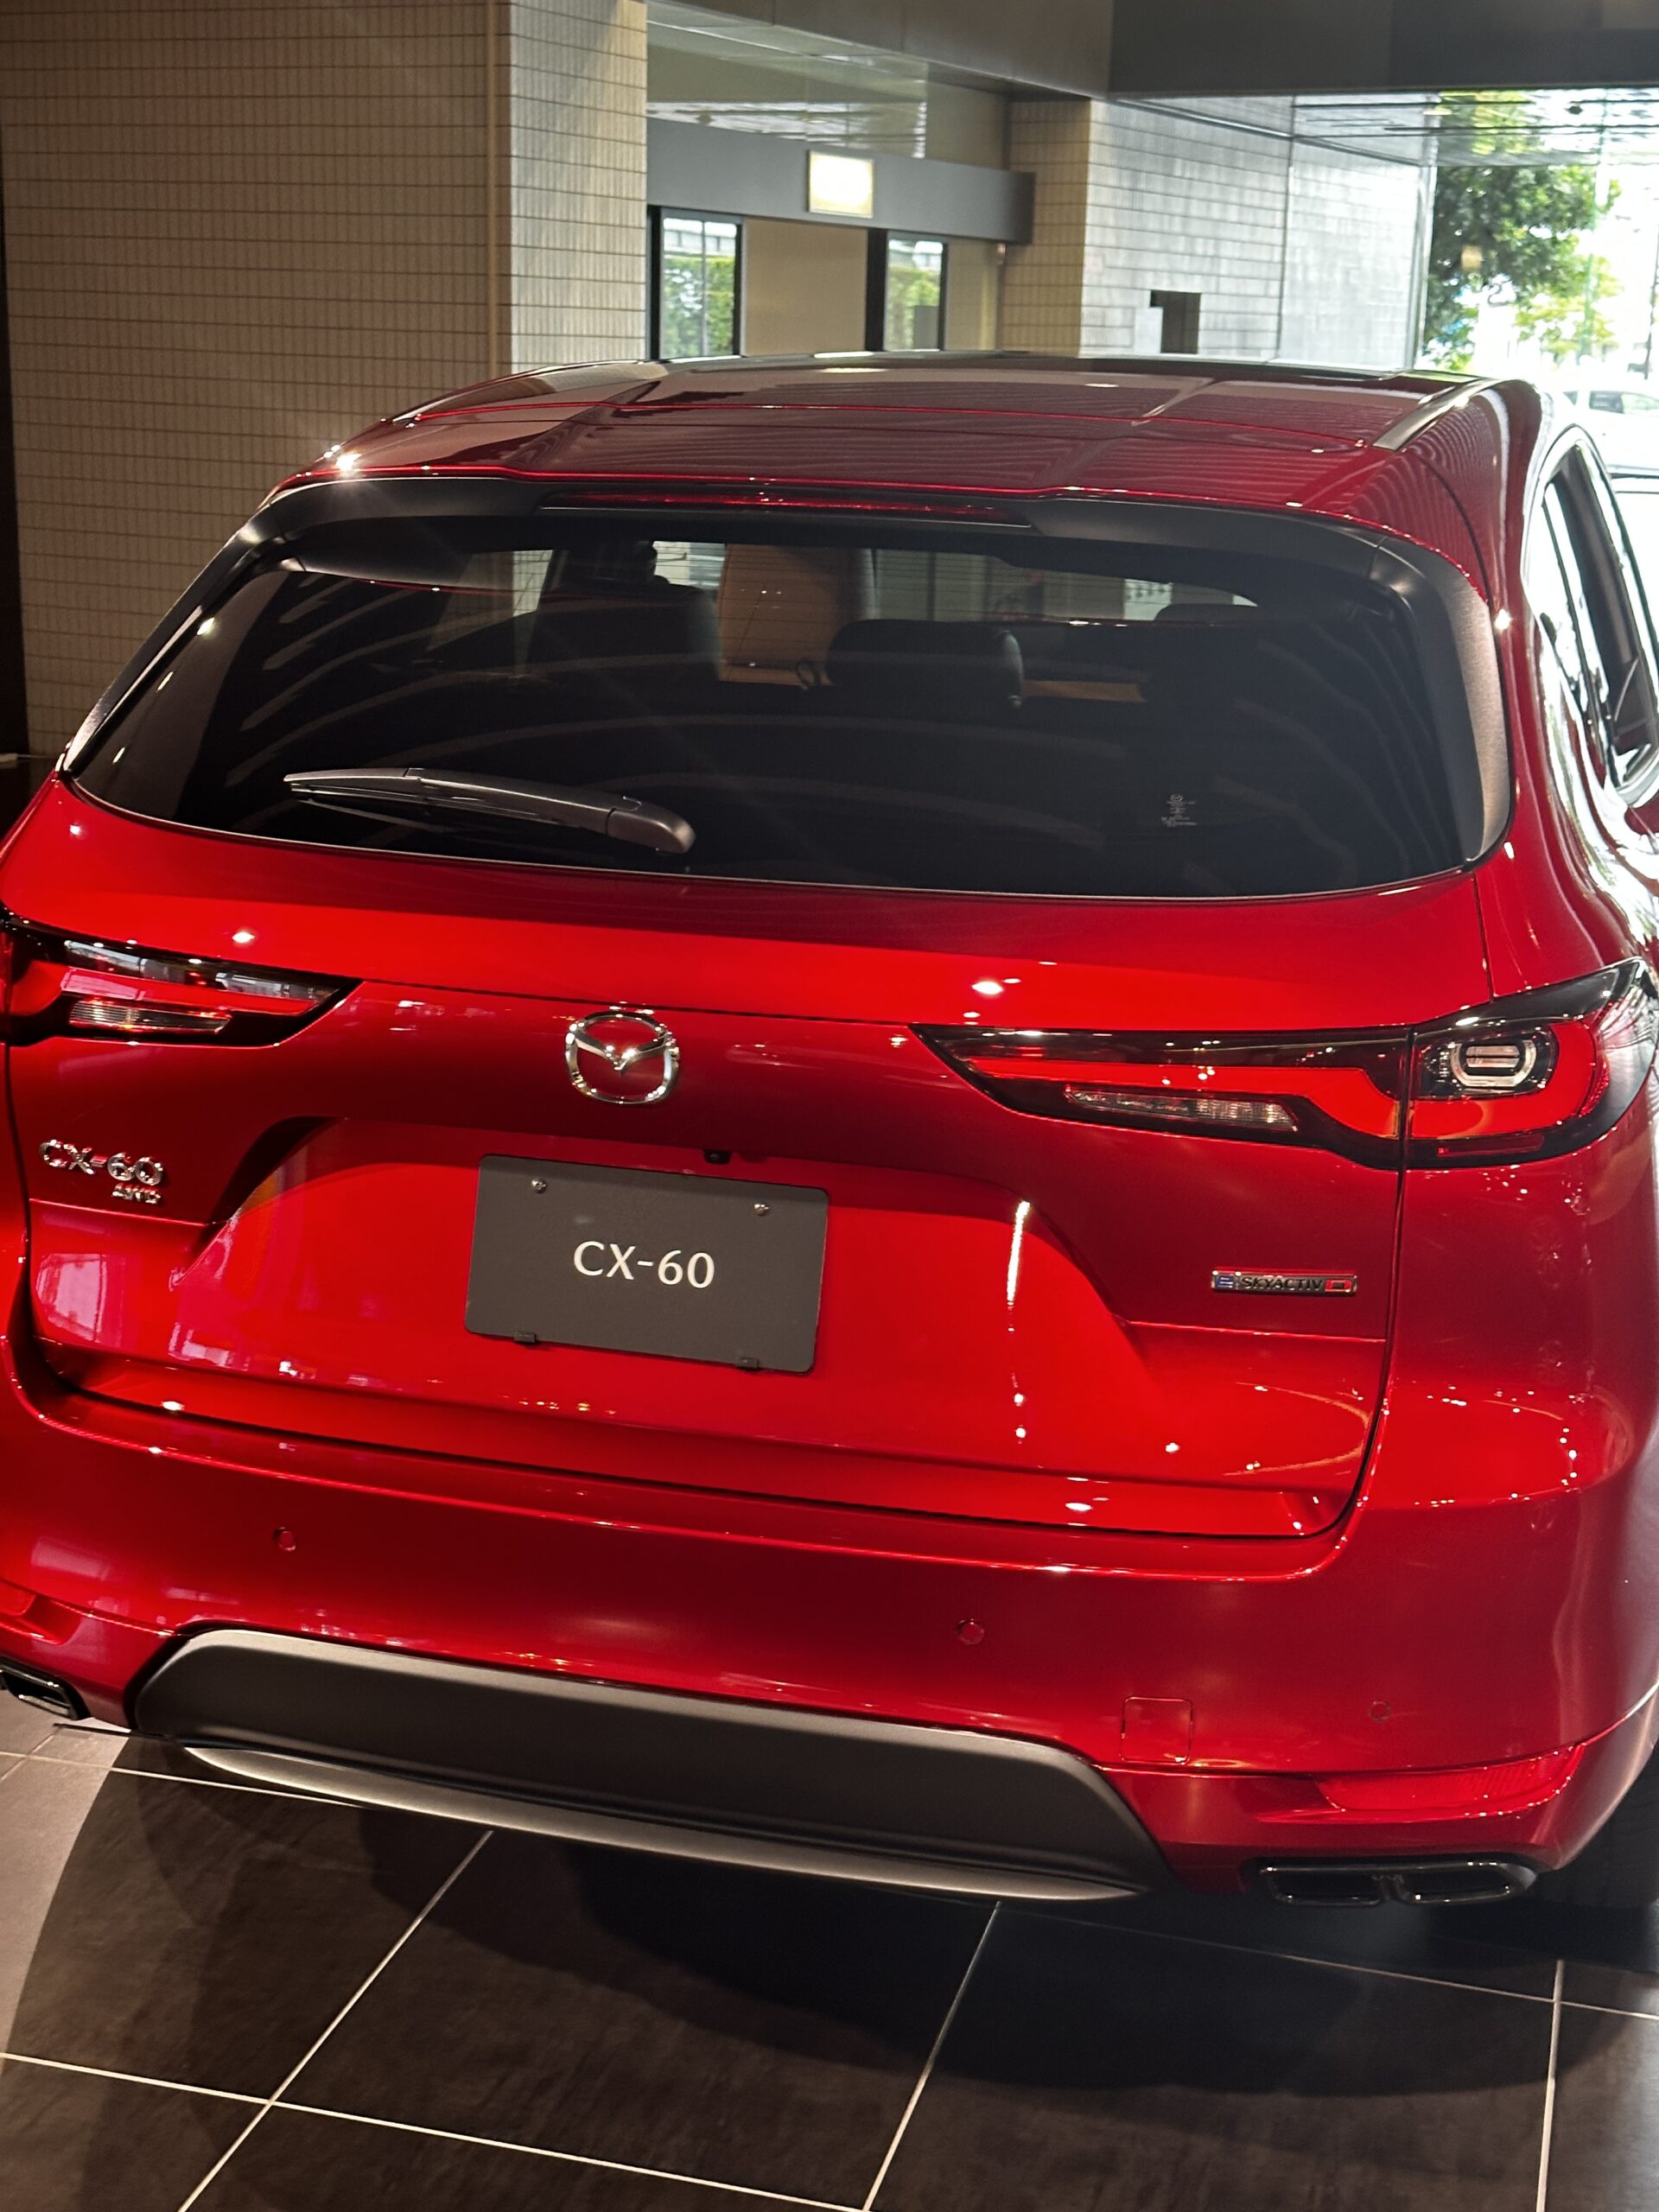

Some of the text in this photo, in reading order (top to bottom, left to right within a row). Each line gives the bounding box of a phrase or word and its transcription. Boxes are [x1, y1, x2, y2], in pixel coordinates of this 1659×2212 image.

[39, 1140, 164, 1185] CX-60
[573, 1241, 715, 1288] CX-60
[1241, 1276, 1324, 1291] SKYACTIV
